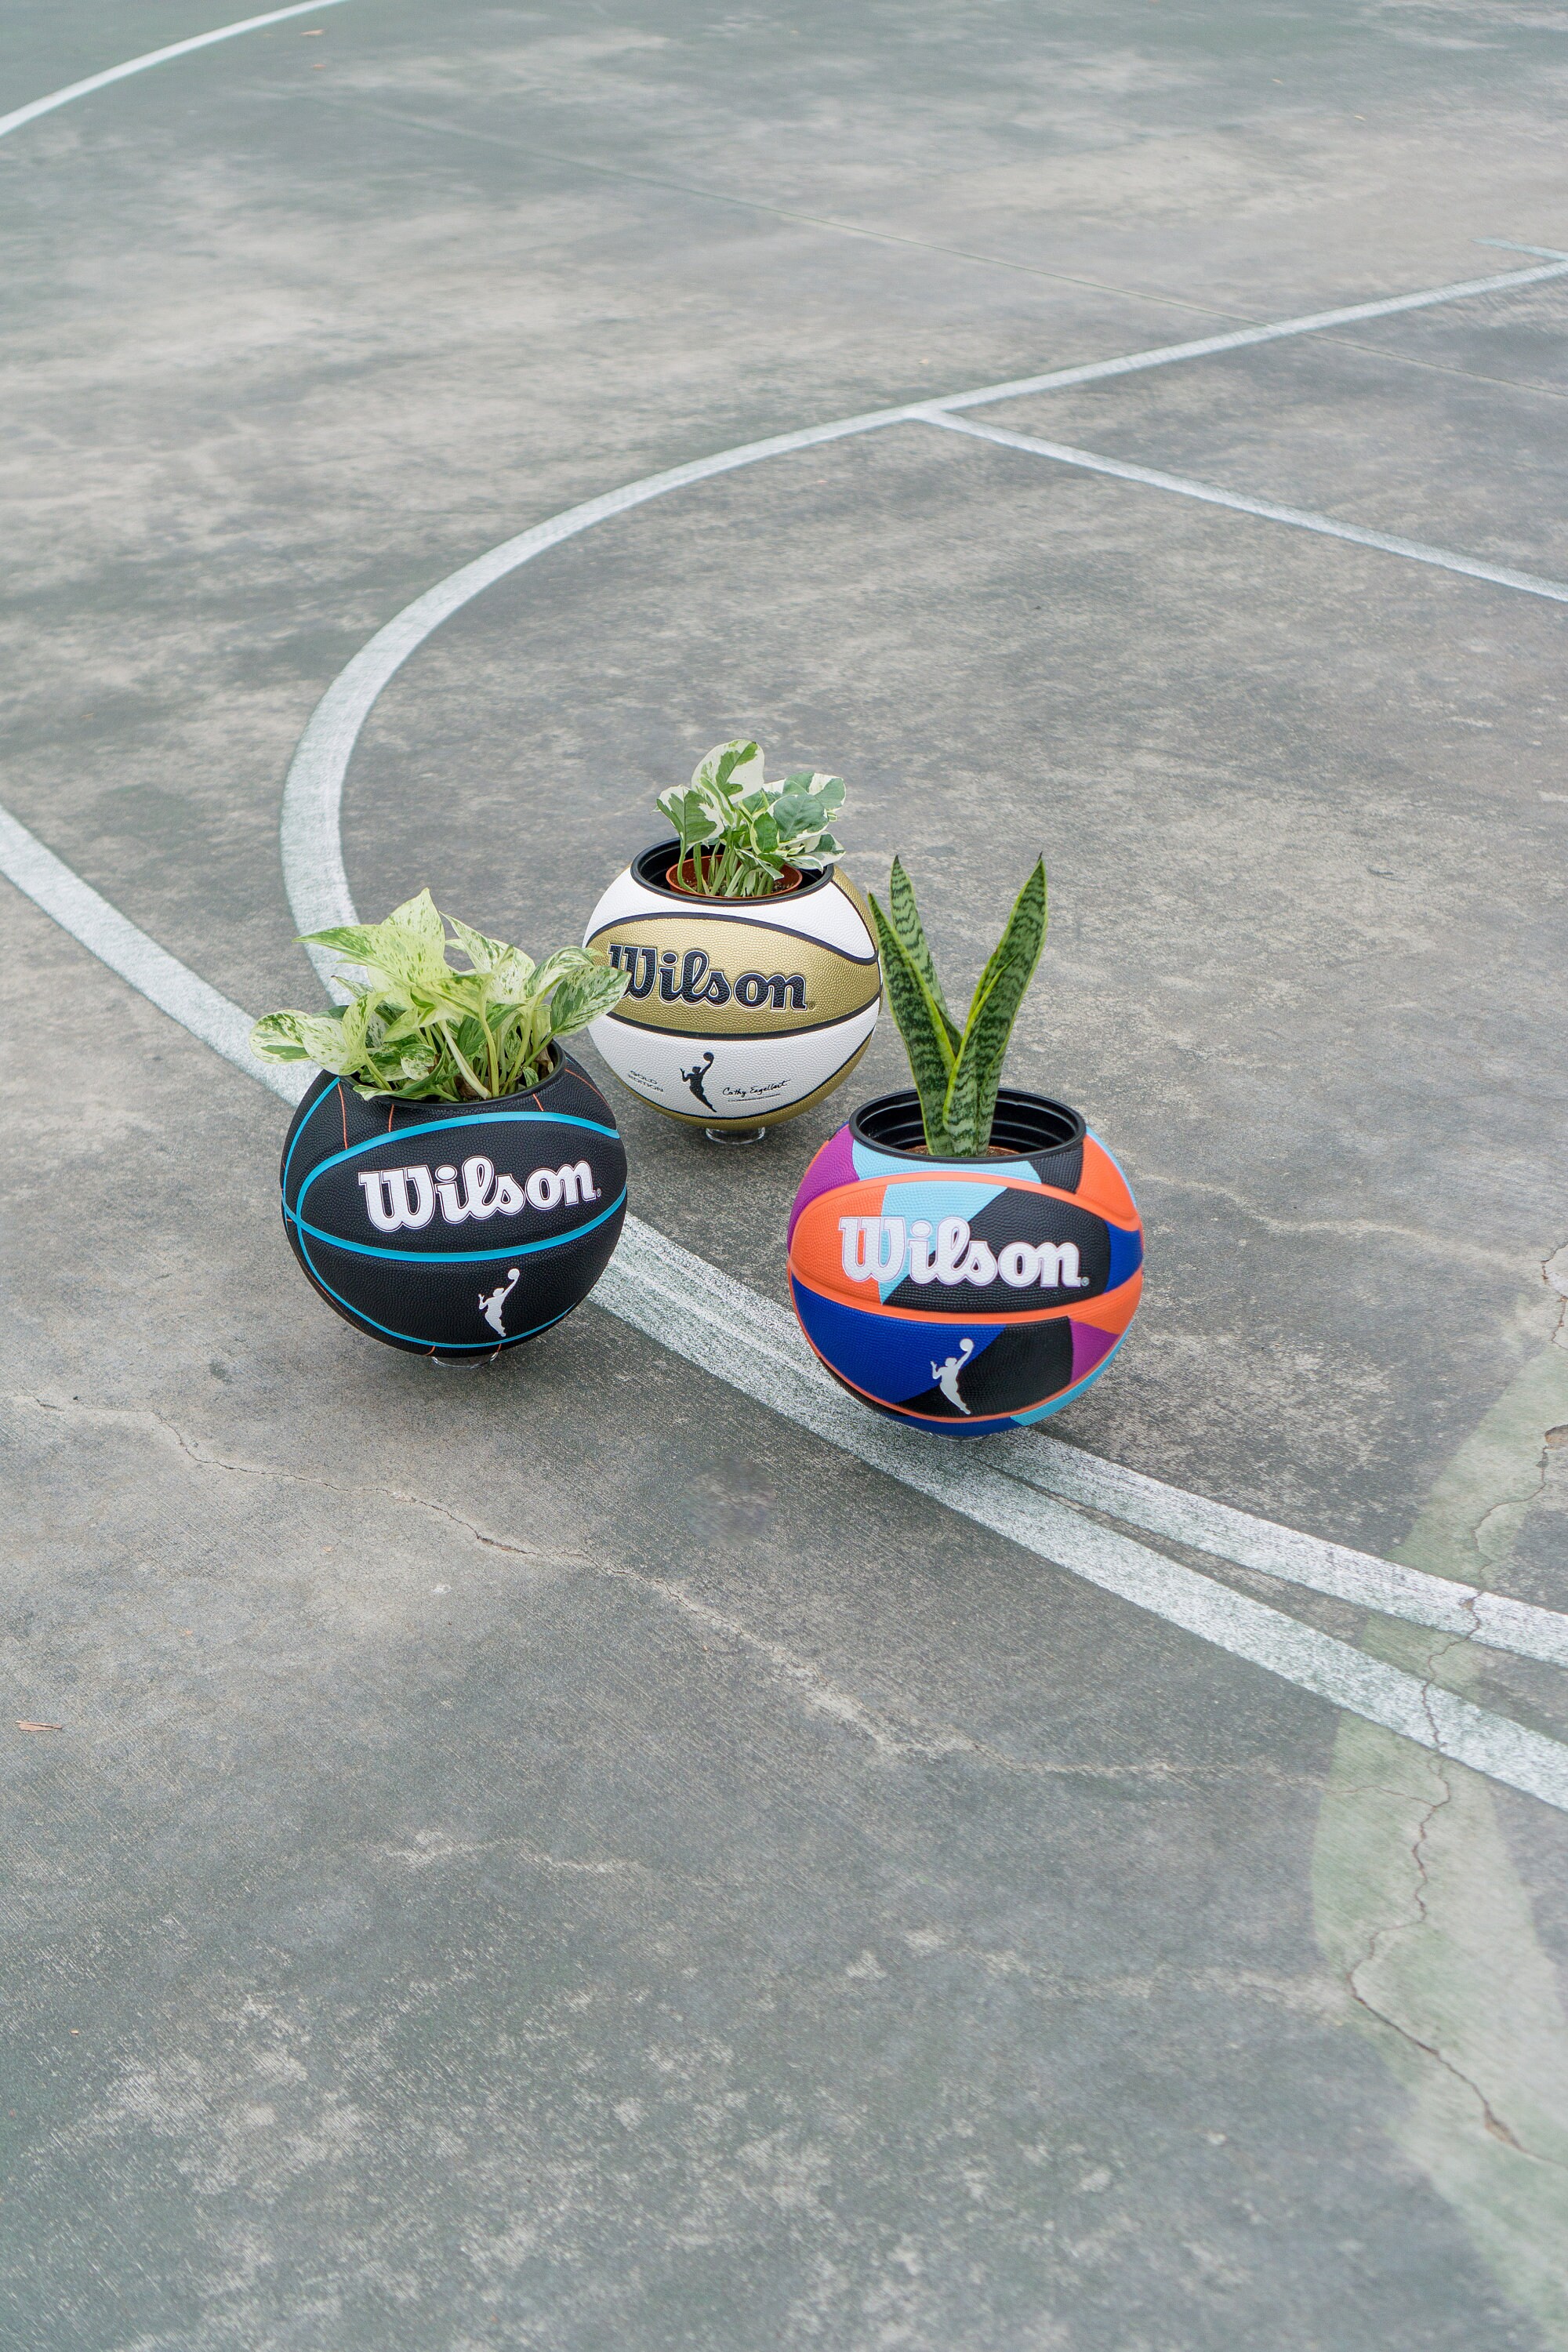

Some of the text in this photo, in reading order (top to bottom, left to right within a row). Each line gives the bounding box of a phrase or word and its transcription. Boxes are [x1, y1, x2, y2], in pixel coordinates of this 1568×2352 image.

[608, 943, 808, 1011] Wilson
[358, 1155, 596, 1232] Wilson
[838, 1216, 1082, 1287] Wilson
